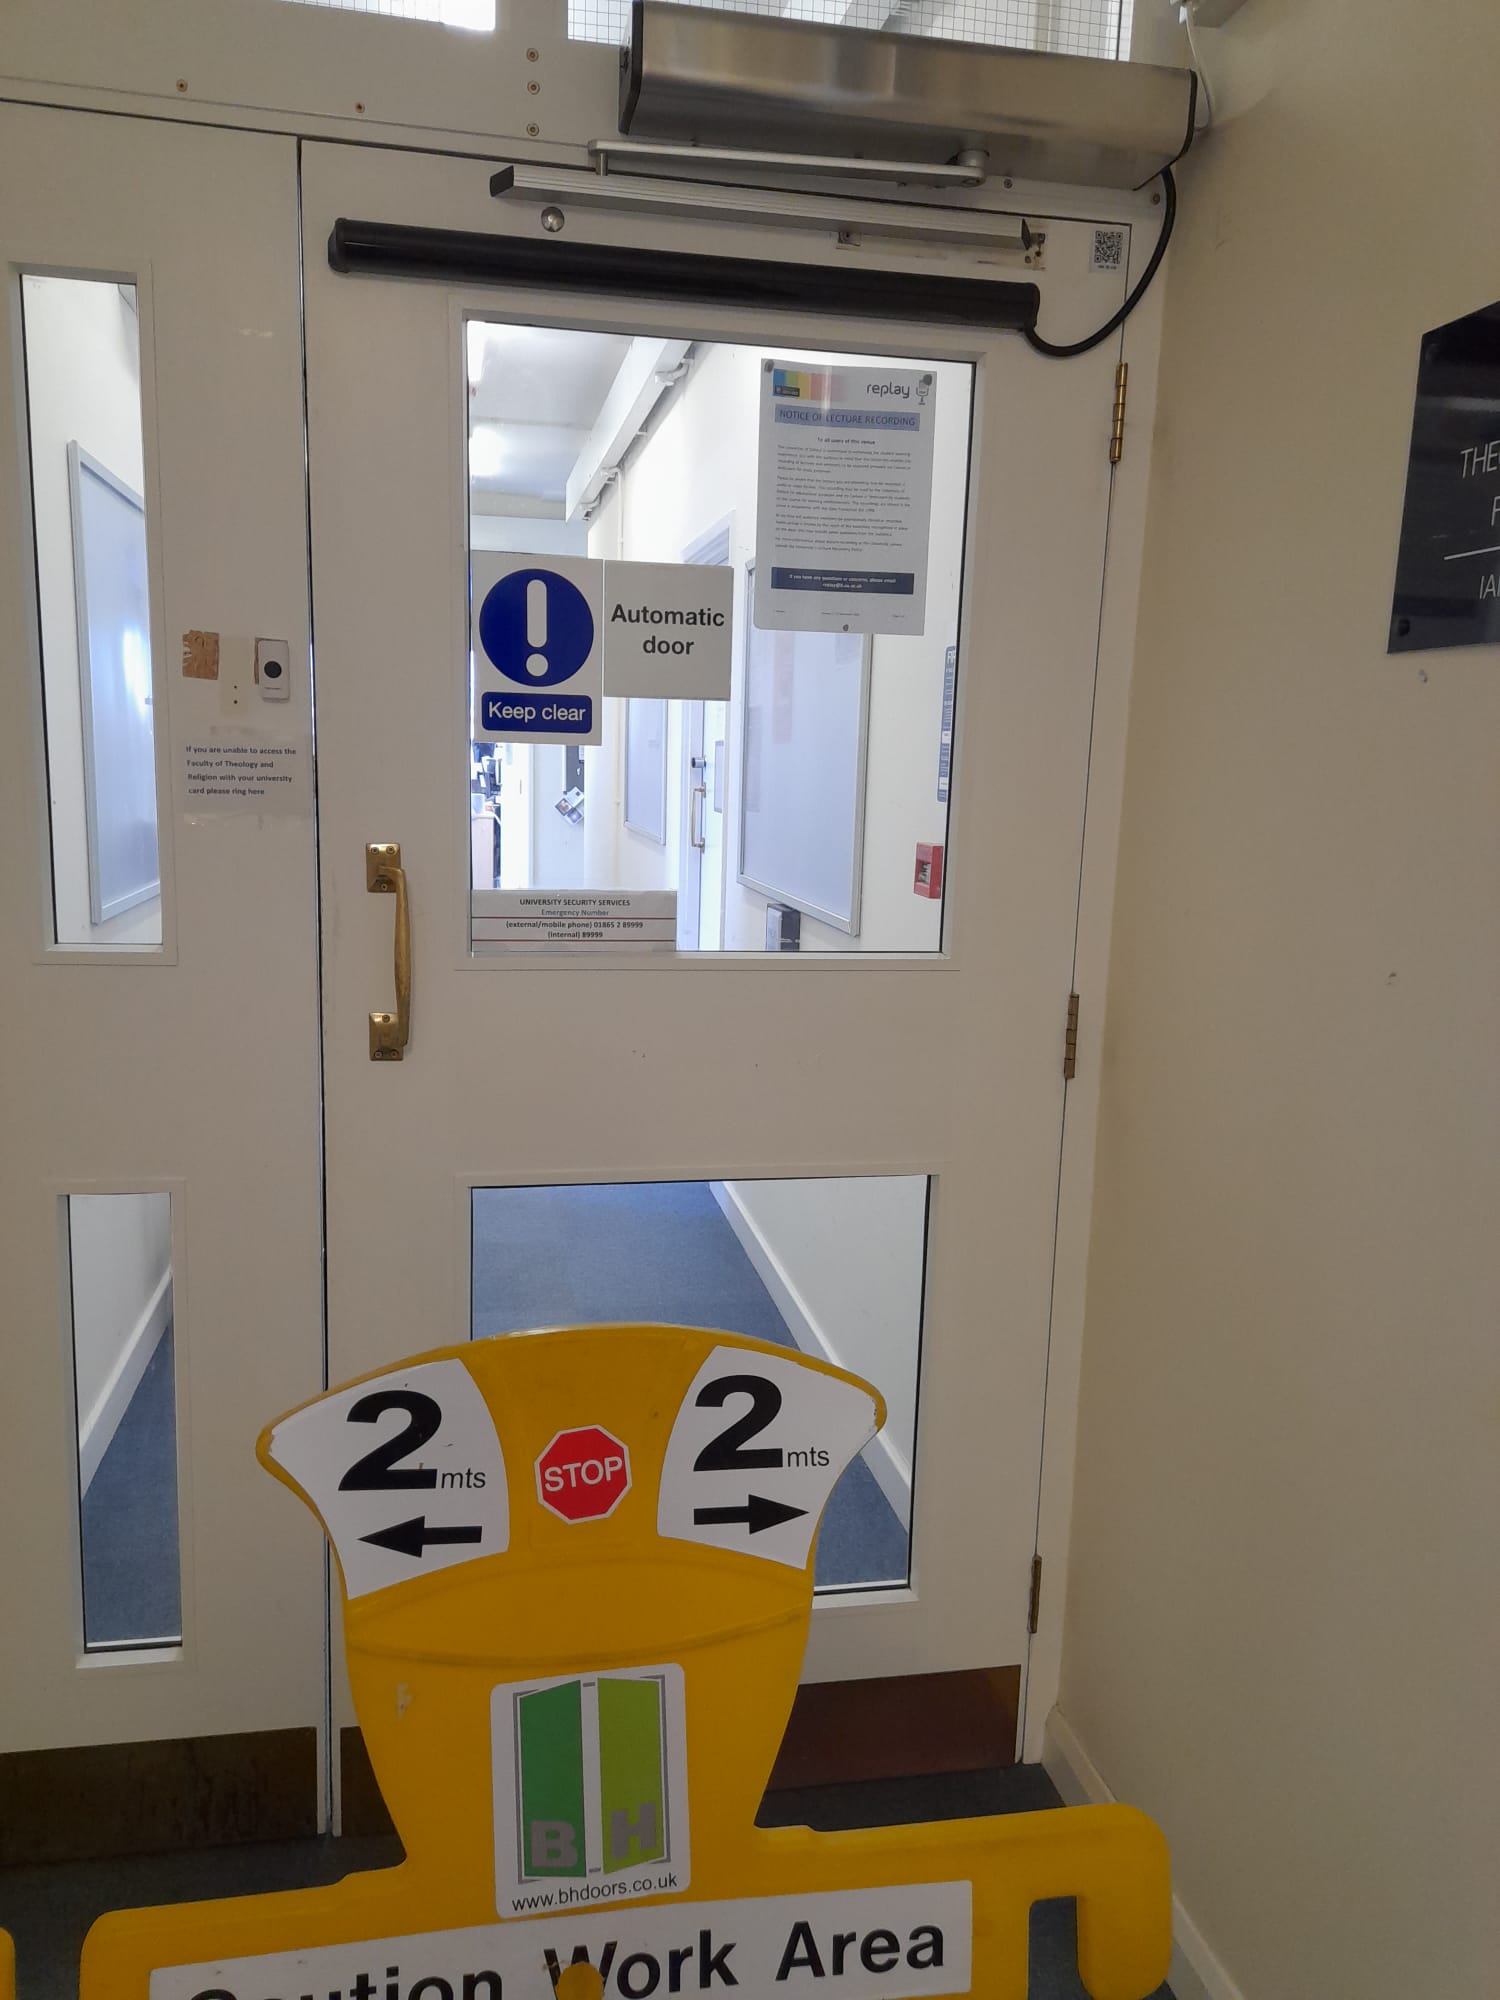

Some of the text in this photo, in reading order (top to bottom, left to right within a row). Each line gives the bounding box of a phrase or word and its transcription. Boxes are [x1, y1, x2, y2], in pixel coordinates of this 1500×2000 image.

[866, 382, 910, 398] replay
[779, 409, 809, 421] NOTICE
[826, 413, 861, 424] LECTURE
[865, 415, 916, 426] RECORDING
[1460, 440, 1500, 478] THE
[1479, 574, 1500, 600] IA
[611, 604, 725, 627] Automatic
[642, 636, 694, 655] door
[488, 701, 586, 723] Keep clear
[225, 760, 258, 769] Theology
[232, 787, 246, 795] ring
[248, 787, 265, 795] here
[541, 909, 580, 917] Emergency
[506, 920, 566, 929] (external/mobile
[567, 921, 592, 929] phone)
[547, 931, 580, 939] (internal)
[544, 1456, 624, 1492] STOP
[511, 1871, 678, 1912] www.bhdoors.co.uk
[775, 1920, 944, 1982] Area
